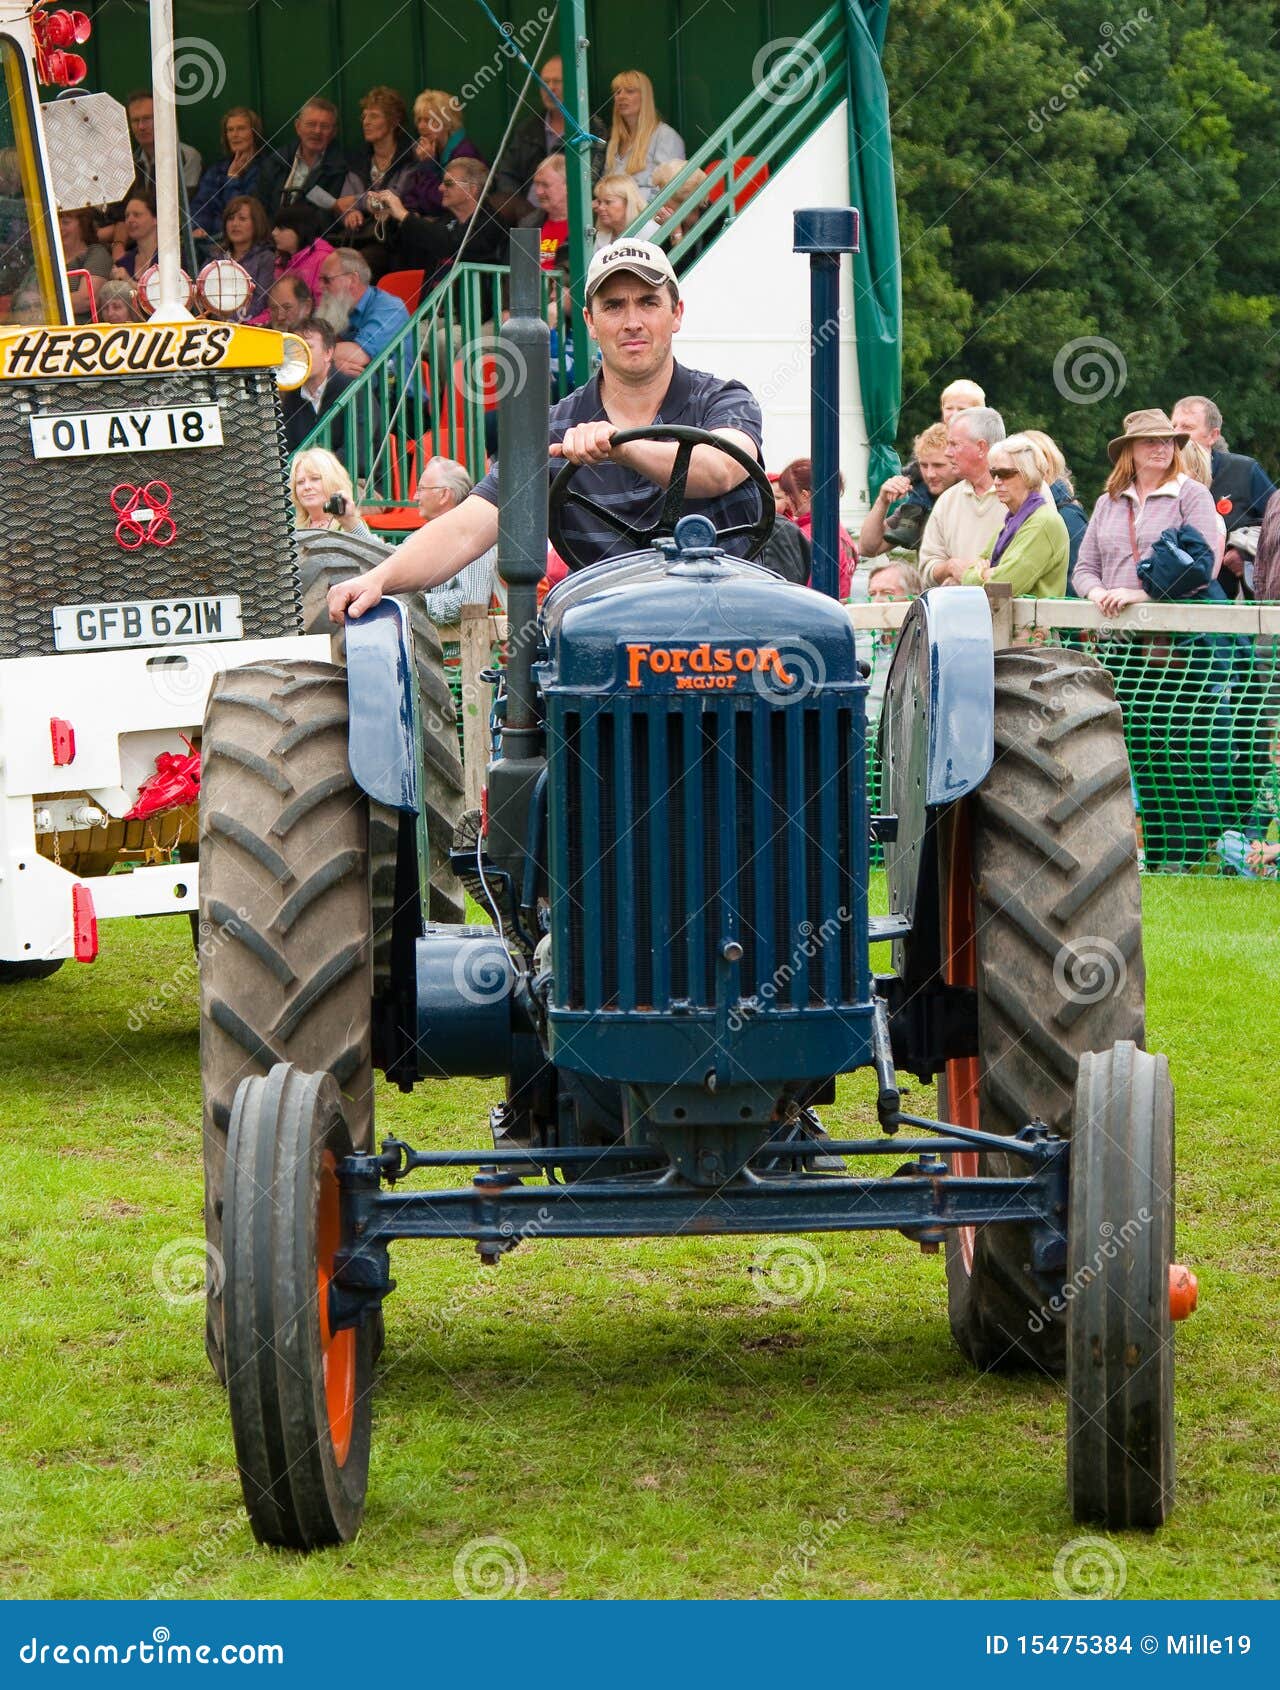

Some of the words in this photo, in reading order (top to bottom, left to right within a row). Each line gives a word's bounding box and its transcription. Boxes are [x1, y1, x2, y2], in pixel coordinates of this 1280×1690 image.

[601, 247, 651, 265] team
[8, 328, 231, 374] HERCULES
[108, 415, 151, 449] AY
[168, 411, 205, 444] 18
[76, 606, 142, 642] GFB
[151, 601, 222, 637] 621W
[626, 643, 796, 688] Fordson
